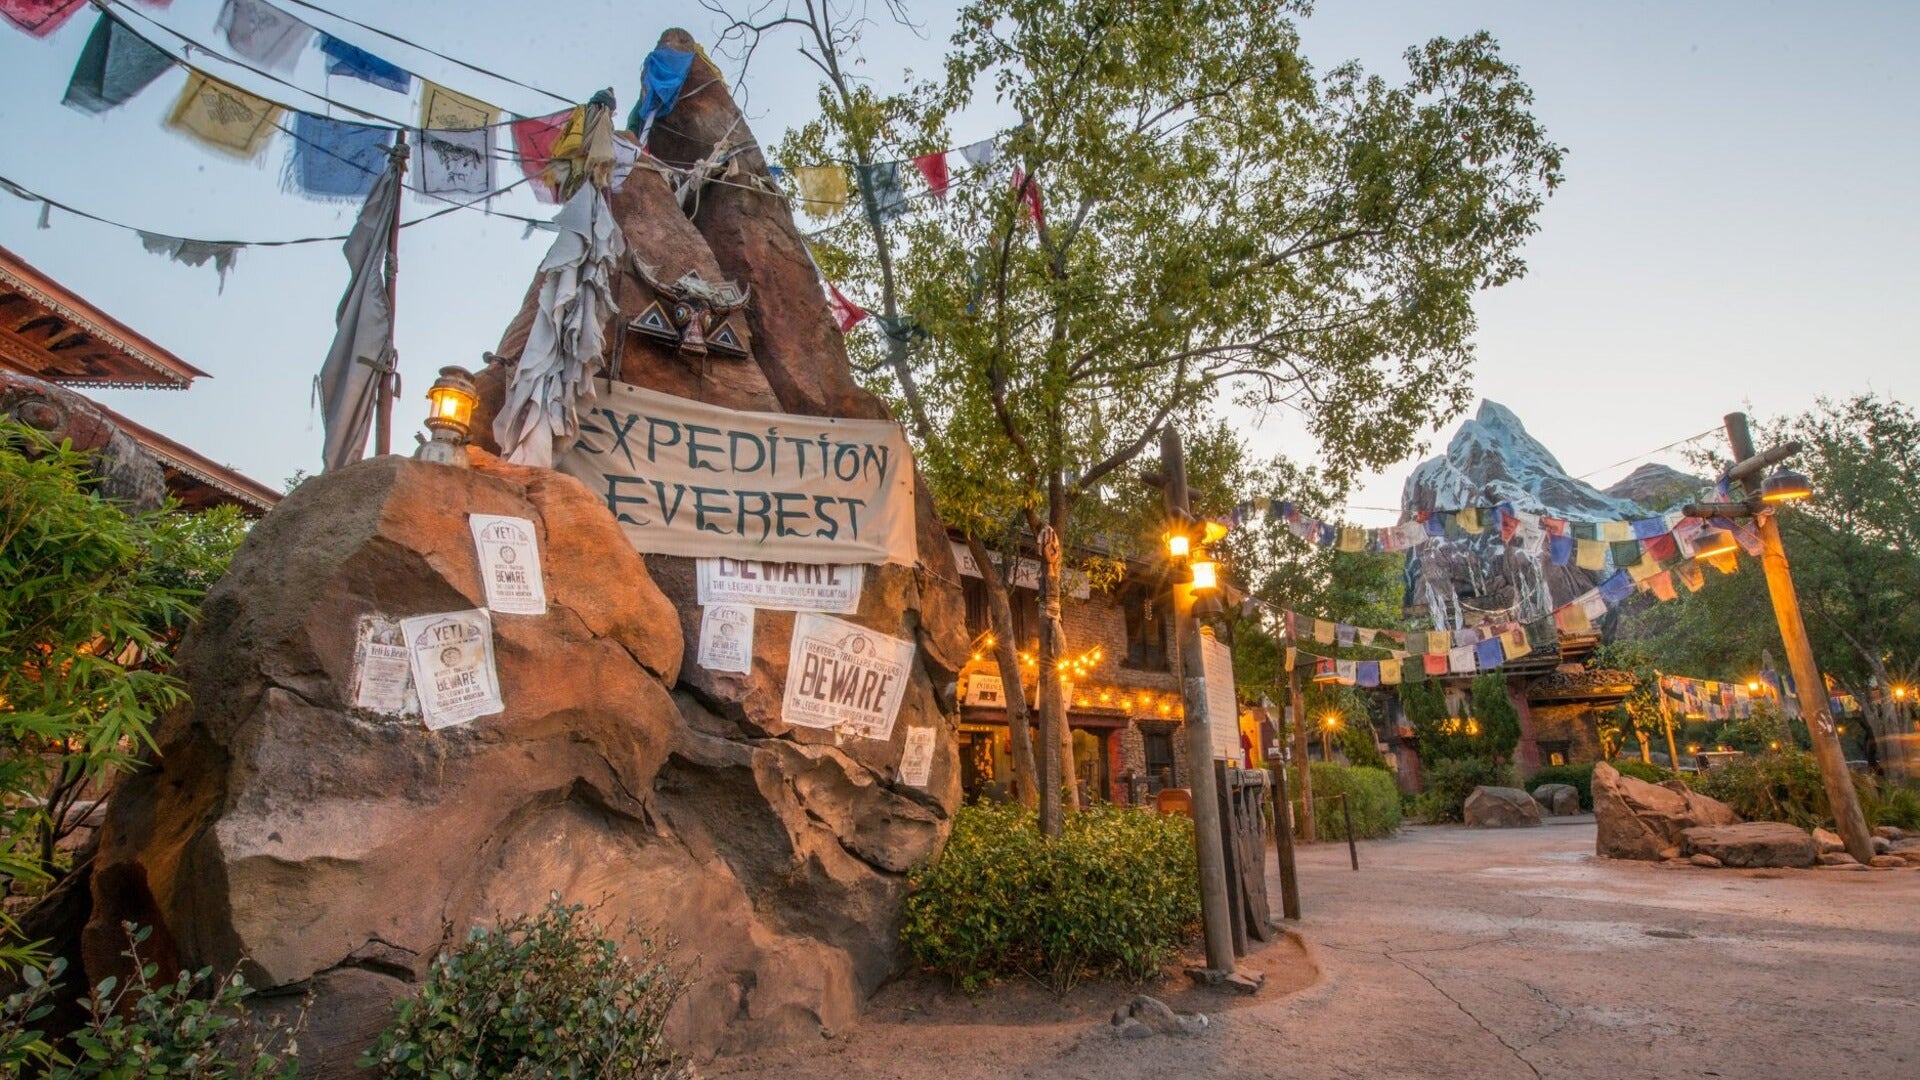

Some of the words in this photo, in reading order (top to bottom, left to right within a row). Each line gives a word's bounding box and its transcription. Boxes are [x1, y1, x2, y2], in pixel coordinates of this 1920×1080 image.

[602, 473, 867, 545] EVEREST
[493, 526, 516, 540] YETI
[495, 569, 526, 584] BEWARE
[433, 624, 464, 642] YETI
[436, 671, 476, 692] BEWARE
[799, 652, 894, 713] BEWARE
